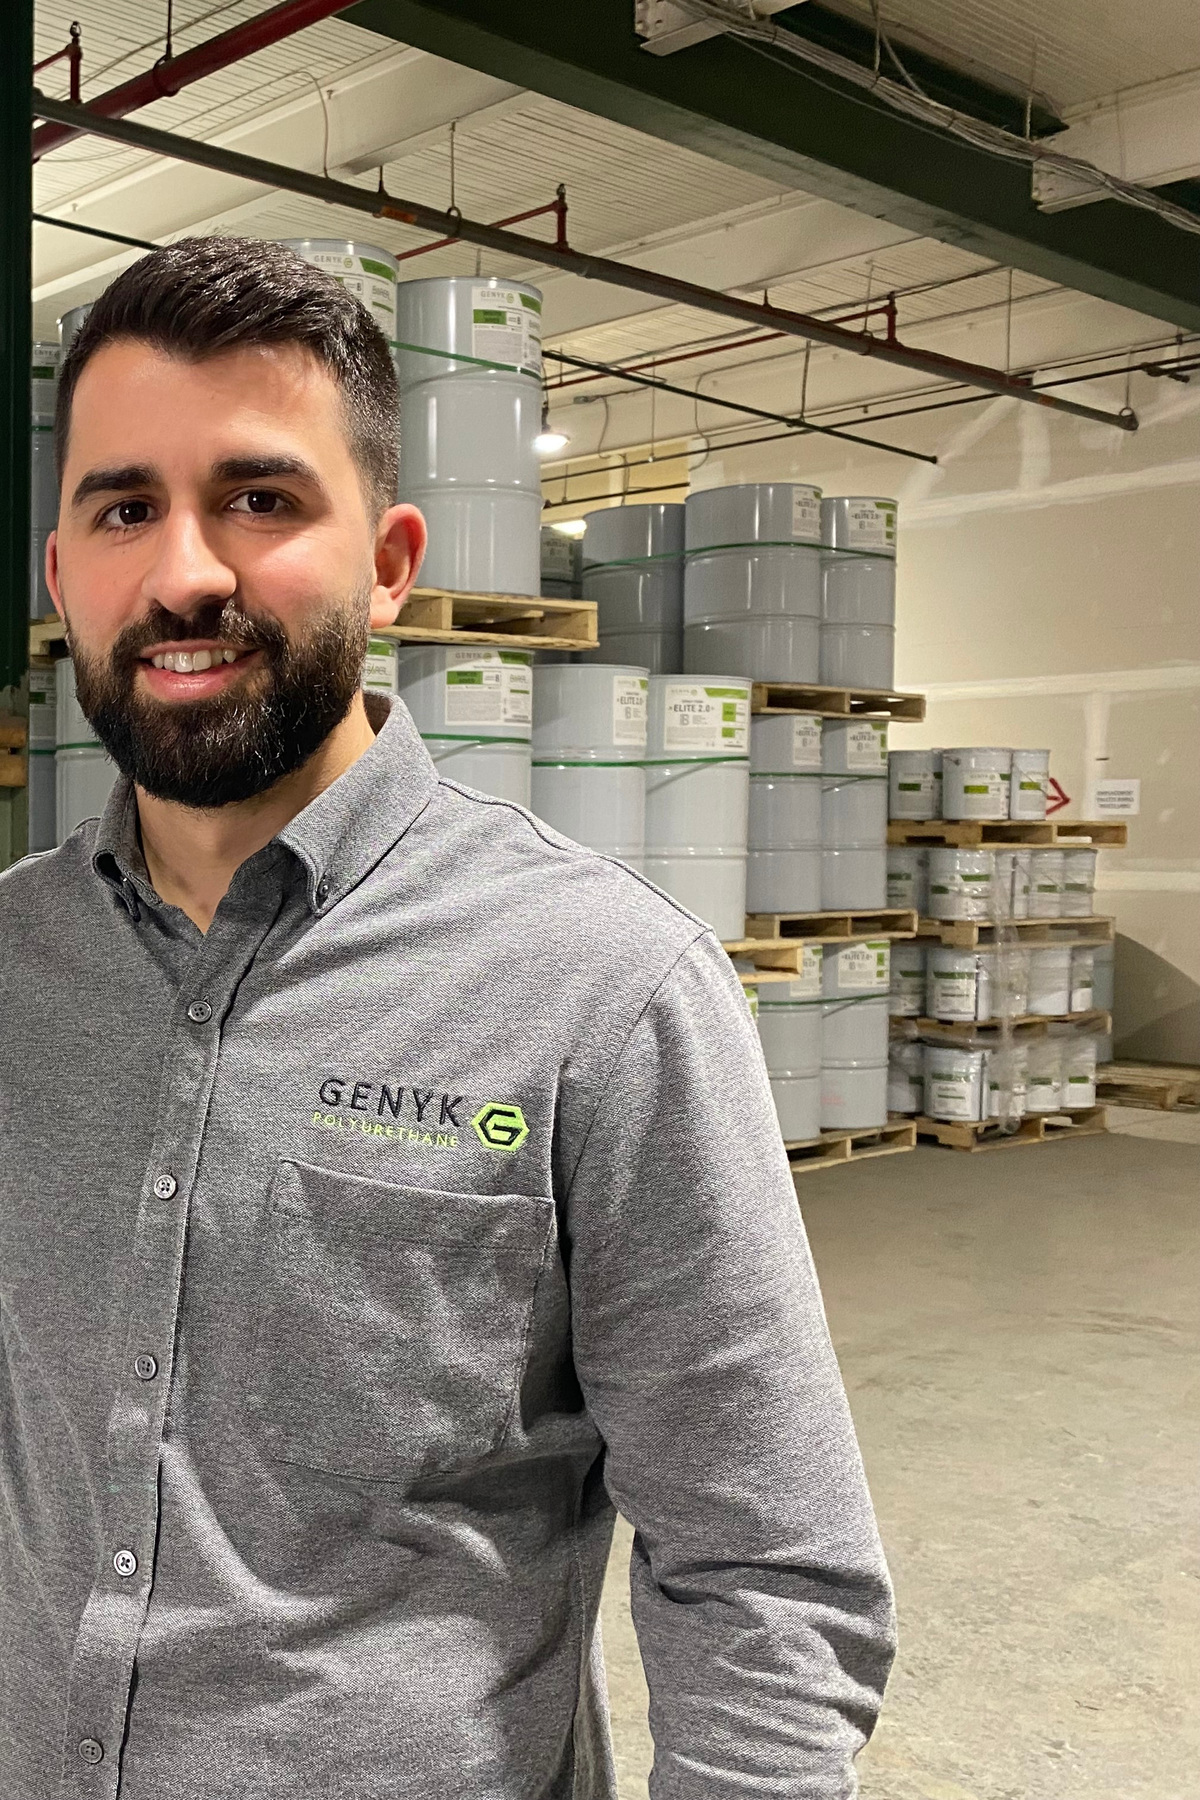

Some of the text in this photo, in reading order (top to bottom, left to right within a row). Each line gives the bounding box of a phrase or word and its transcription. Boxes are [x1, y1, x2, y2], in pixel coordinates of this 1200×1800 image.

[673, 704, 711, 713] ELITE 2.0
[318, 1078, 464, 1128] GENYK
[311, 1110, 459, 1149] POLYURETHANE
